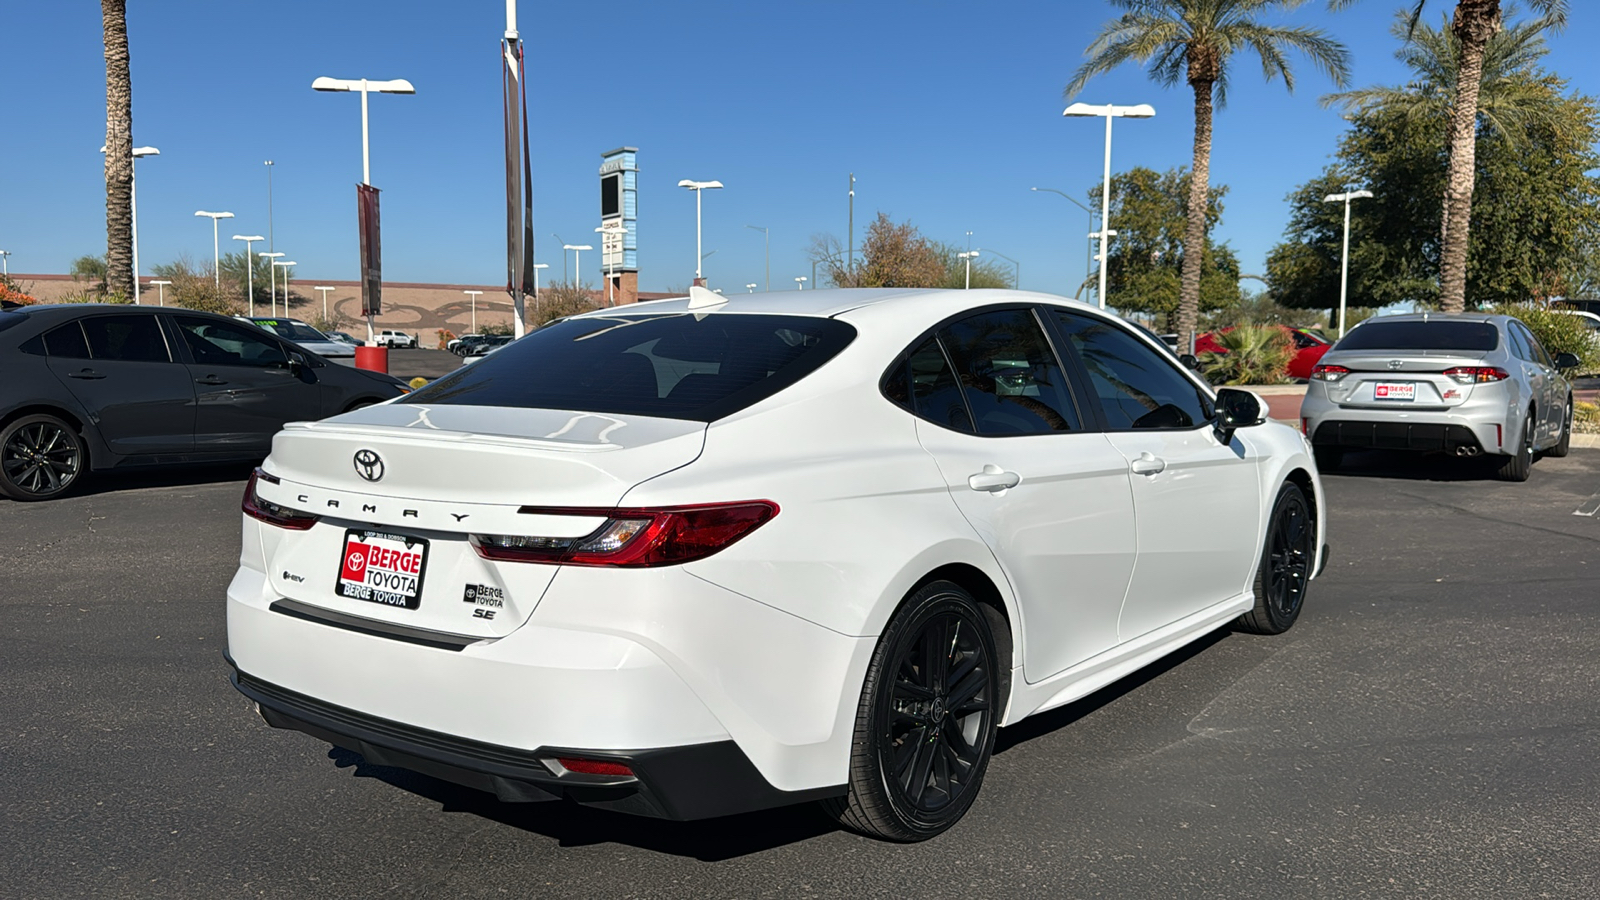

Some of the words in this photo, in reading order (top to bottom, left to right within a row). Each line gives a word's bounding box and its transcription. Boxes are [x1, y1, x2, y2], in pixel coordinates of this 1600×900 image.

[297, 494, 470, 522] CAMRY
[388, 534, 406, 542] DOBSON
[369, 545, 421, 574] BERGE
[367, 570, 416, 593] TOYOTA
[343, 584, 372, 599] BERGE
[373, 589, 406, 606] TOYOTA
[478, 584, 504, 599] BERGE
[477, 596, 503, 608] TOYOTA
[472, 608, 497, 620] SE
